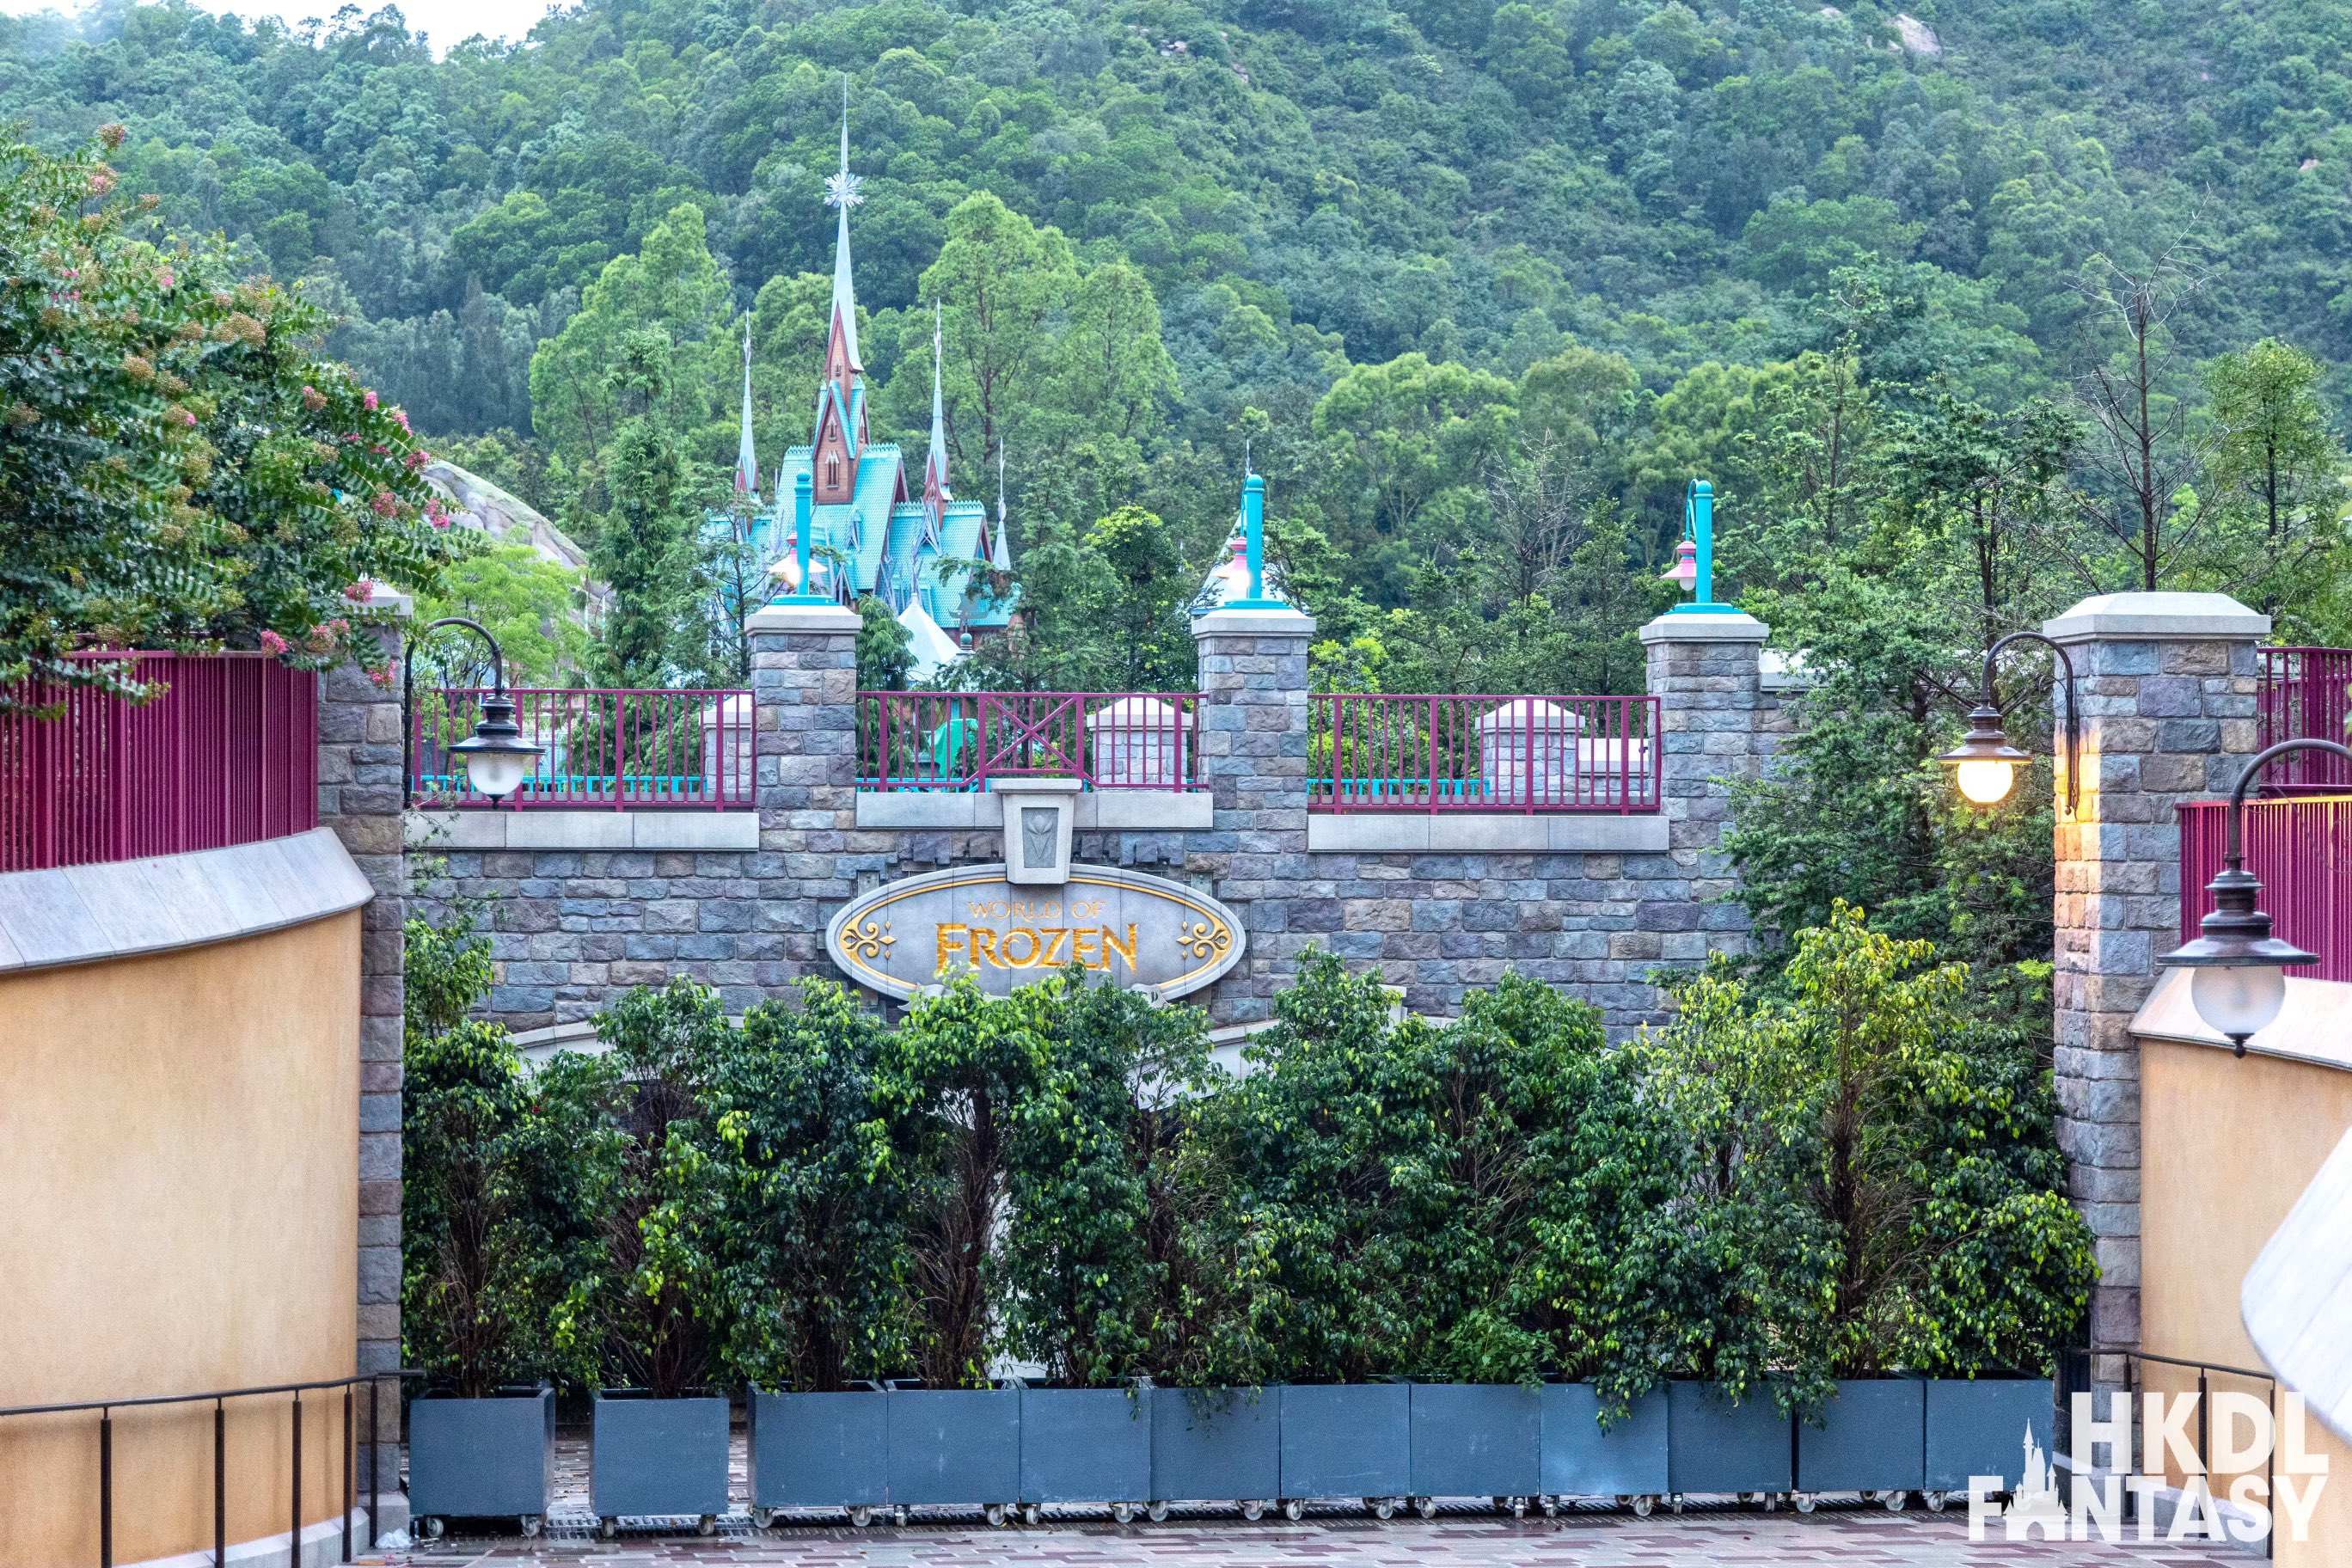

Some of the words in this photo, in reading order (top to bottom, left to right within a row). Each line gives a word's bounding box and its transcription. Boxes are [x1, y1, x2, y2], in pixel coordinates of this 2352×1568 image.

[968, 900, 1062, 922] WORLD
[1072, 901, 1107, 919] OF
[935, 922, 1138, 976] FROZEN
